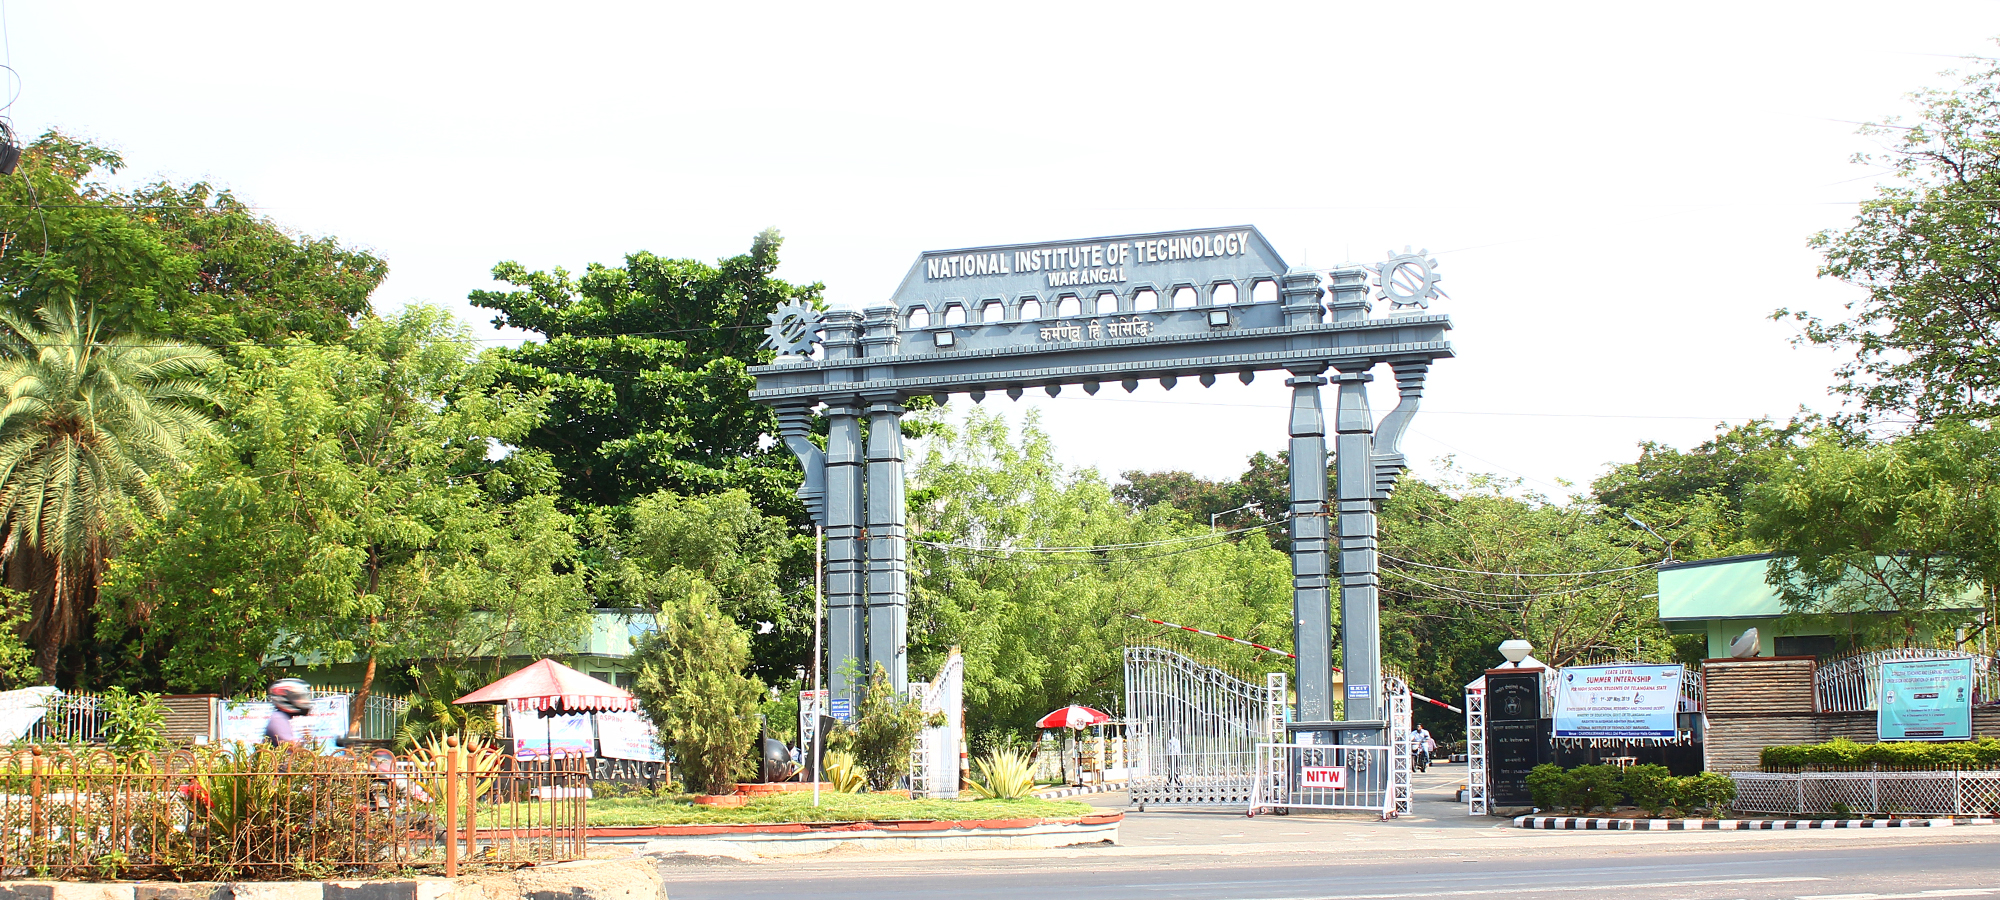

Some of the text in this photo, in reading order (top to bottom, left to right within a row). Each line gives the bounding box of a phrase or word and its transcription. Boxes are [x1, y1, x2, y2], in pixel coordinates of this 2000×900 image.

[927, 231, 1249, 280] NATIONAL INSTITUTE OF TECHNOLOGY
[1047, 267, 1127, 287] WARANGAL
[1087, 318, 1101, 341] हि
[1586, 675, 1652, 684] SUMMER INTERNSHIP
[1306, 770, 1340, 783] NITW
